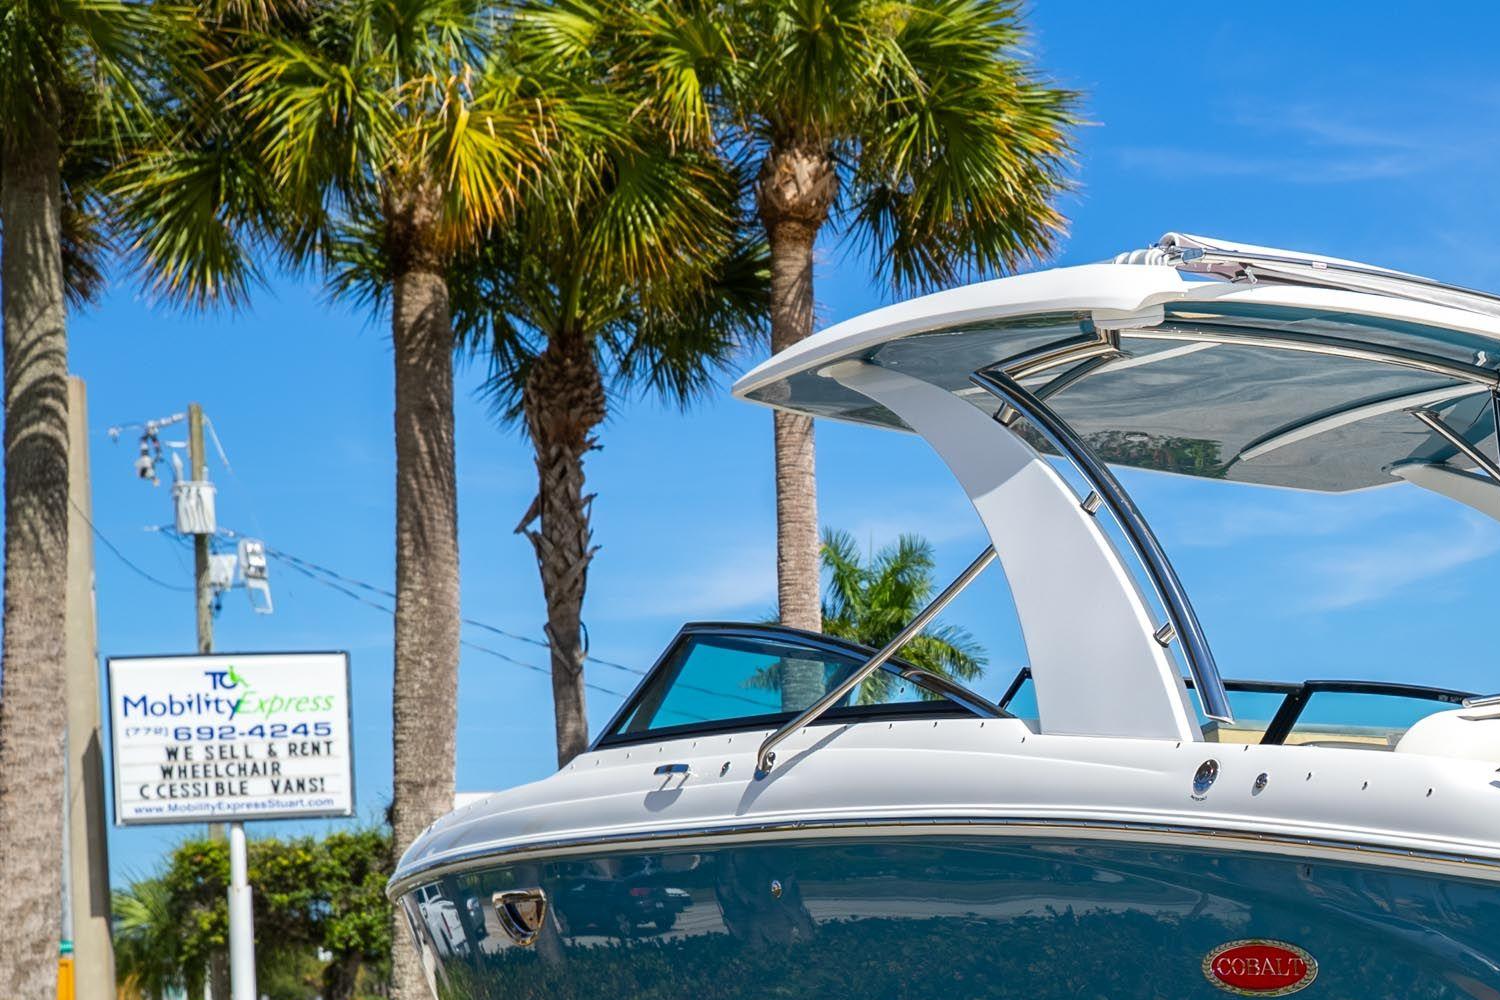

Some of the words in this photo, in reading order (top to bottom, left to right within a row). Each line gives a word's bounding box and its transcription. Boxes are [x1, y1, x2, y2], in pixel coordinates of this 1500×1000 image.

[174, 722, 332, 741] 692-4245
[165, 745, 193, 762] WE
[205, 744, 253, 761] SELL
[267, 742, 279, 758] &
[288, 740, 334, 758] RENT
[160, 761, 283, 780] WHEELCHAIR
[270, 777, 326, 795] VANS!
[1217, 958, 1304, 976] COBALT
